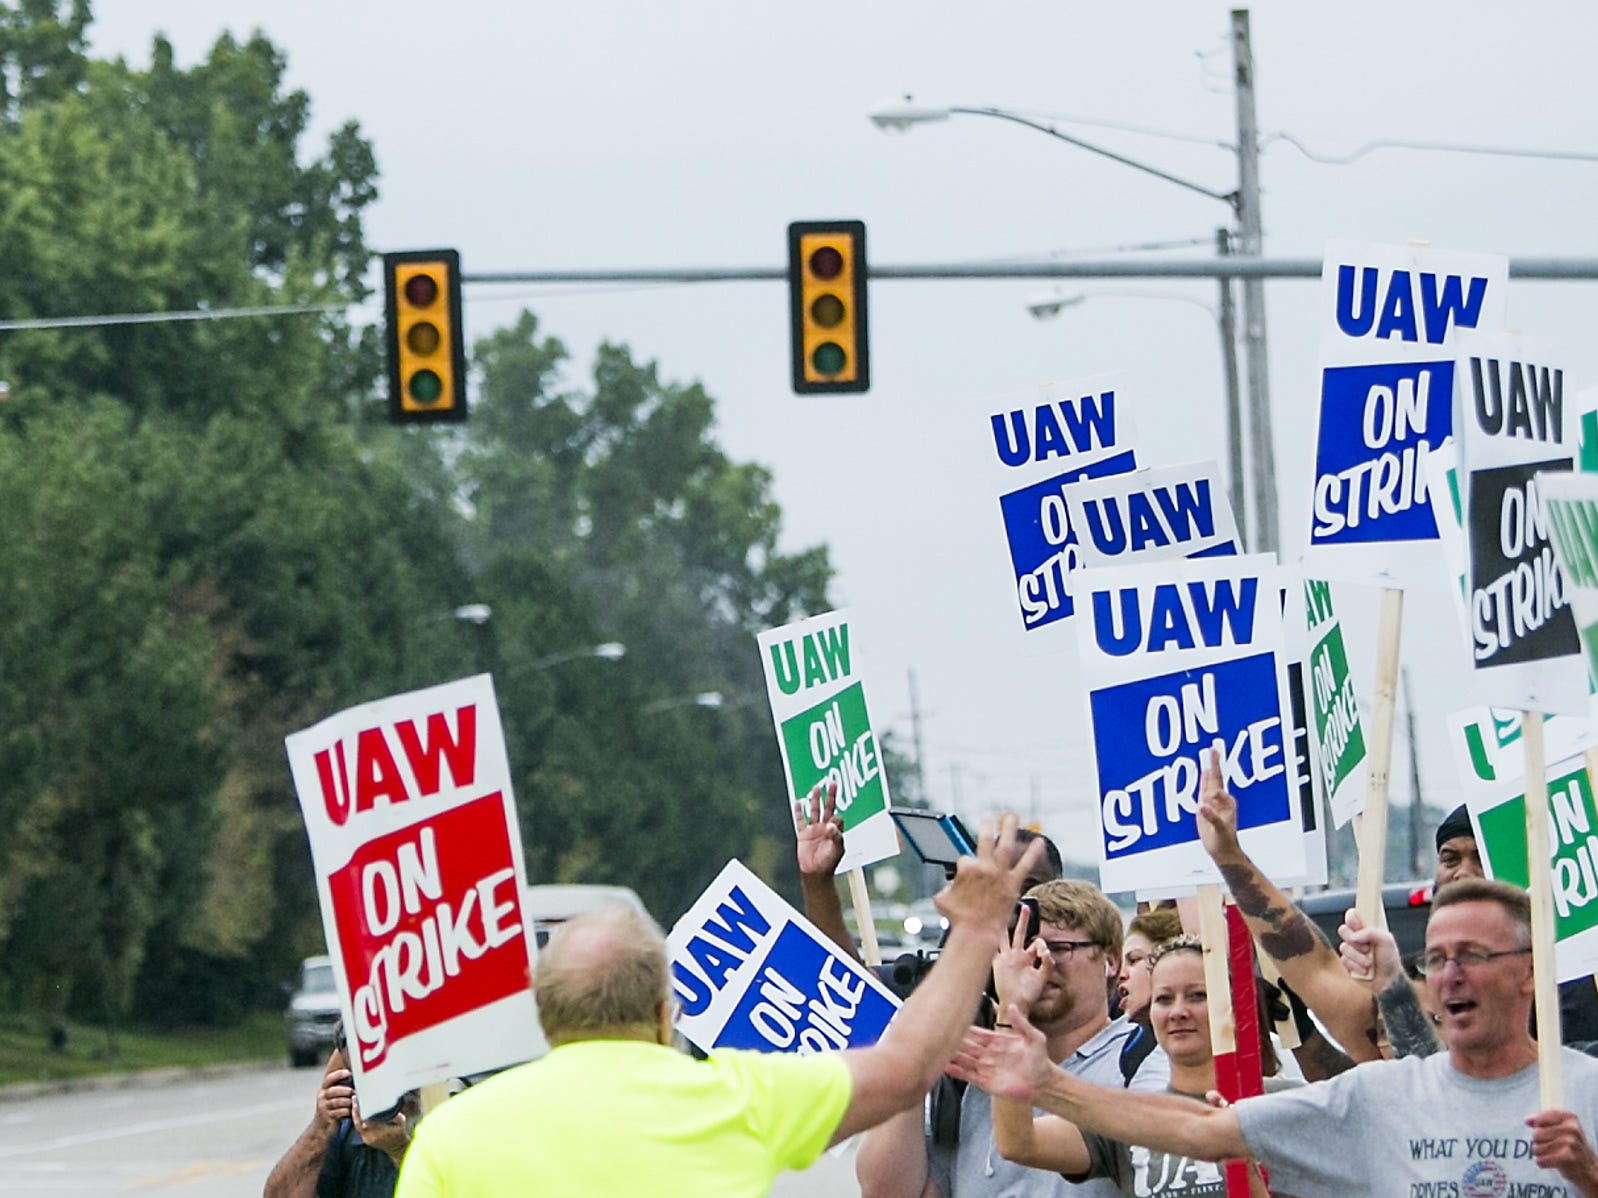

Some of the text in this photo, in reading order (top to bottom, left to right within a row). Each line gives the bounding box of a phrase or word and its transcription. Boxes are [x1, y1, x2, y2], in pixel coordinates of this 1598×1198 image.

[1335, 265, 1488, 345] UAW
[990, 391, 1115, 467] UAW
[1363, 370, 1429, 449] ON
[1470, 357, 1563, 444] UAW
[1082, 479, 1215, 556] UAW
[1501, 480, 1547, 558] ON
[1018, 543, 1083, 623] STR
[1092, 577, 1258, 657] UAW
[1473, 547, 1568, 661] STRIK
[770, 623, 851, 696] UAW
[1314, 643, 1336, 714] ON
[809, 701, 846, 770] ON
[1145, 673, 1219, 757] ON
[1321, 673, 1359, 794] STRIKE
[314, 703, 477, 827] UAW
[361, 826, 442, 937] ON
[354, 866, 522, 1064] STRIKE
[671, 885, 772, 1016] UAW
[749, 967, 806, 1048] ON
[1409, 1138, 1458, 1160] WHAT
[1466, 1138, 1508, 1159] YOU
